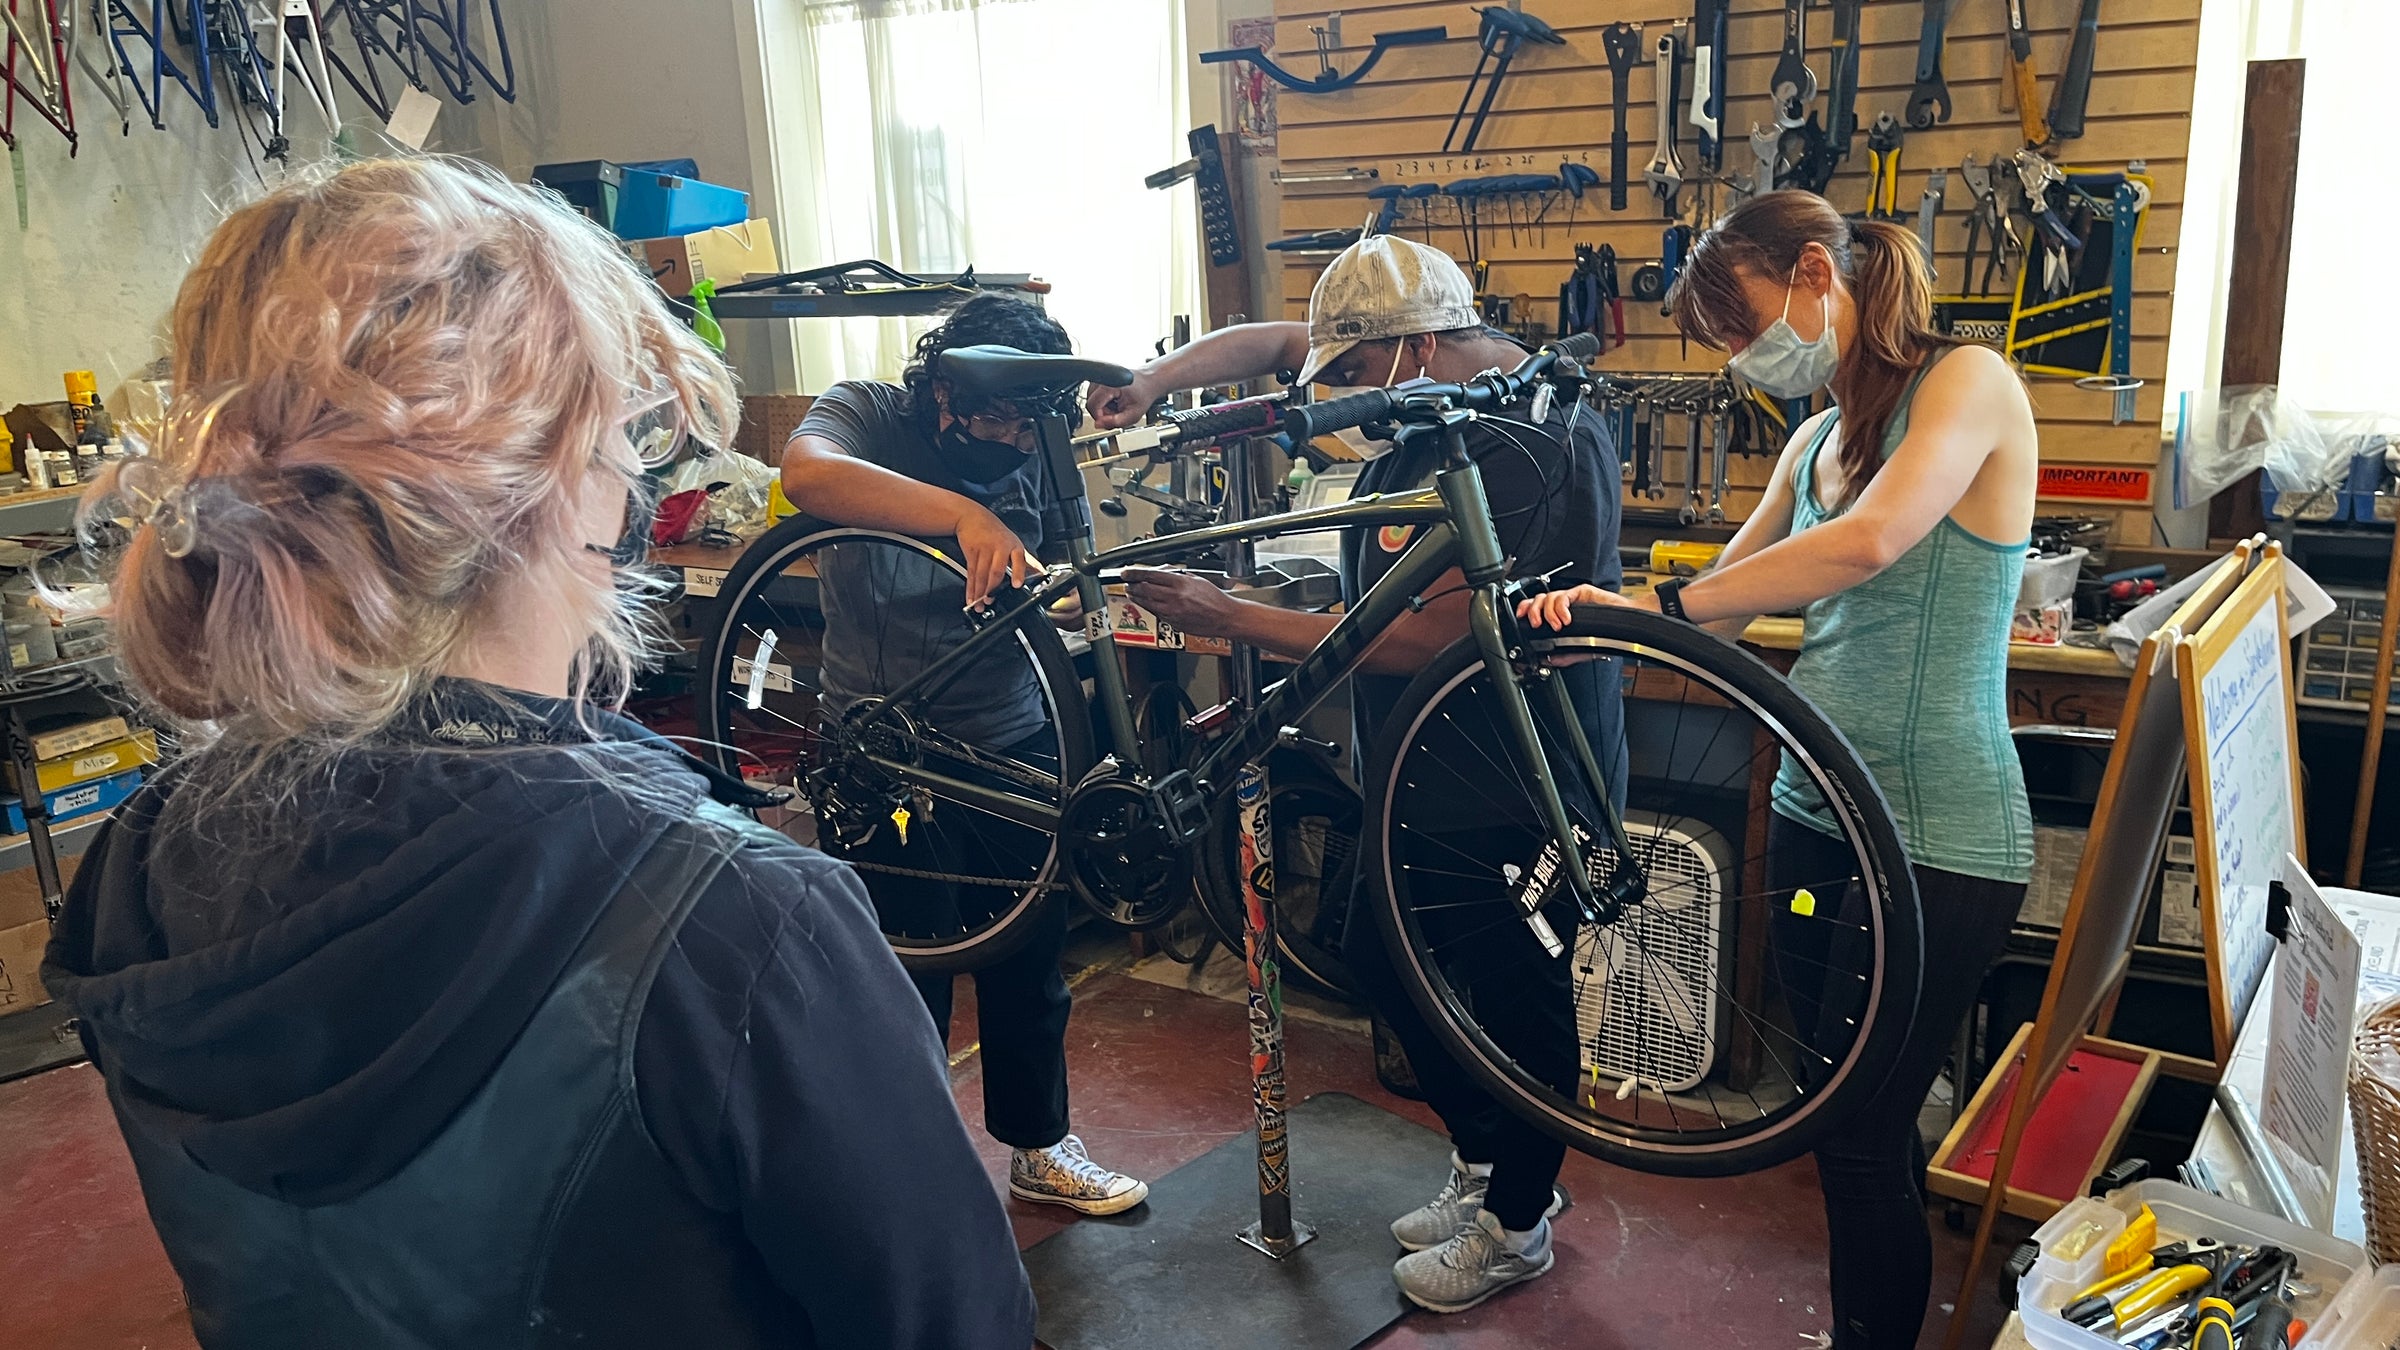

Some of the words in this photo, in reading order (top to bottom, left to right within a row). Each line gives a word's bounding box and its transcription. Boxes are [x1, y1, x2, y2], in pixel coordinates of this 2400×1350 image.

[1396, 163, 1403, 176] 2
[1412, 161, 1419, 174] 3
[2043, 468, 2143, 483] IMPORTANT
[695, 573, 713, 586] SELF
[1544, 844, 1561, 865] IS
[1534, 853, 1557, 886] BIKE
[1521, 877, 1544, 912] THIS
